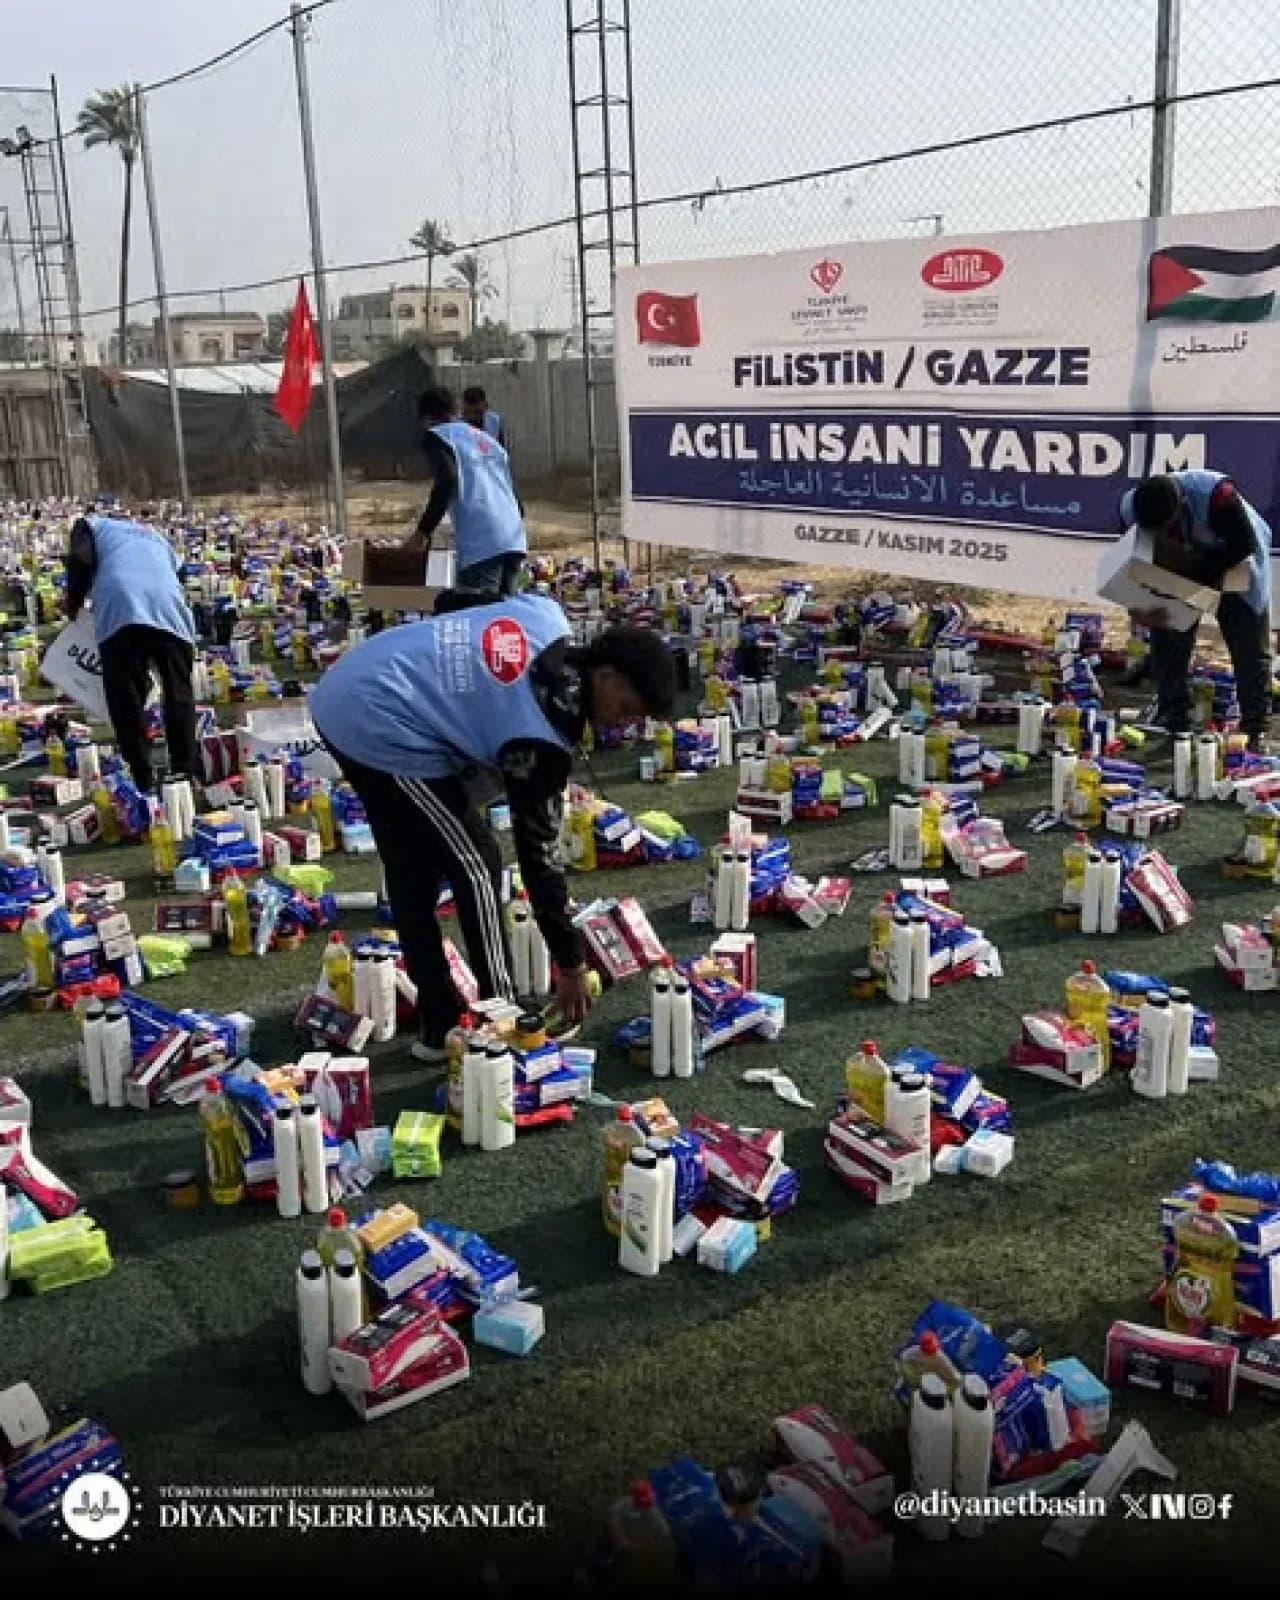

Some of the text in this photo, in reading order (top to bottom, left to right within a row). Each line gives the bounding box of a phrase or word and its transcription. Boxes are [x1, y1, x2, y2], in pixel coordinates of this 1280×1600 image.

[894, 345, 915, 389] /
[924, 346, 1091, 386] GAZZE
[957, 427, 1206, 478] YARDIM
[739, 467, 823, 497] العاجلة
[959, 480, 1082, 514] مساعدة
[794, 523, 861, 546] GAZZE
[877, 530, 944, 555] KASIM
[948, 538, 1009, 562] 2025
